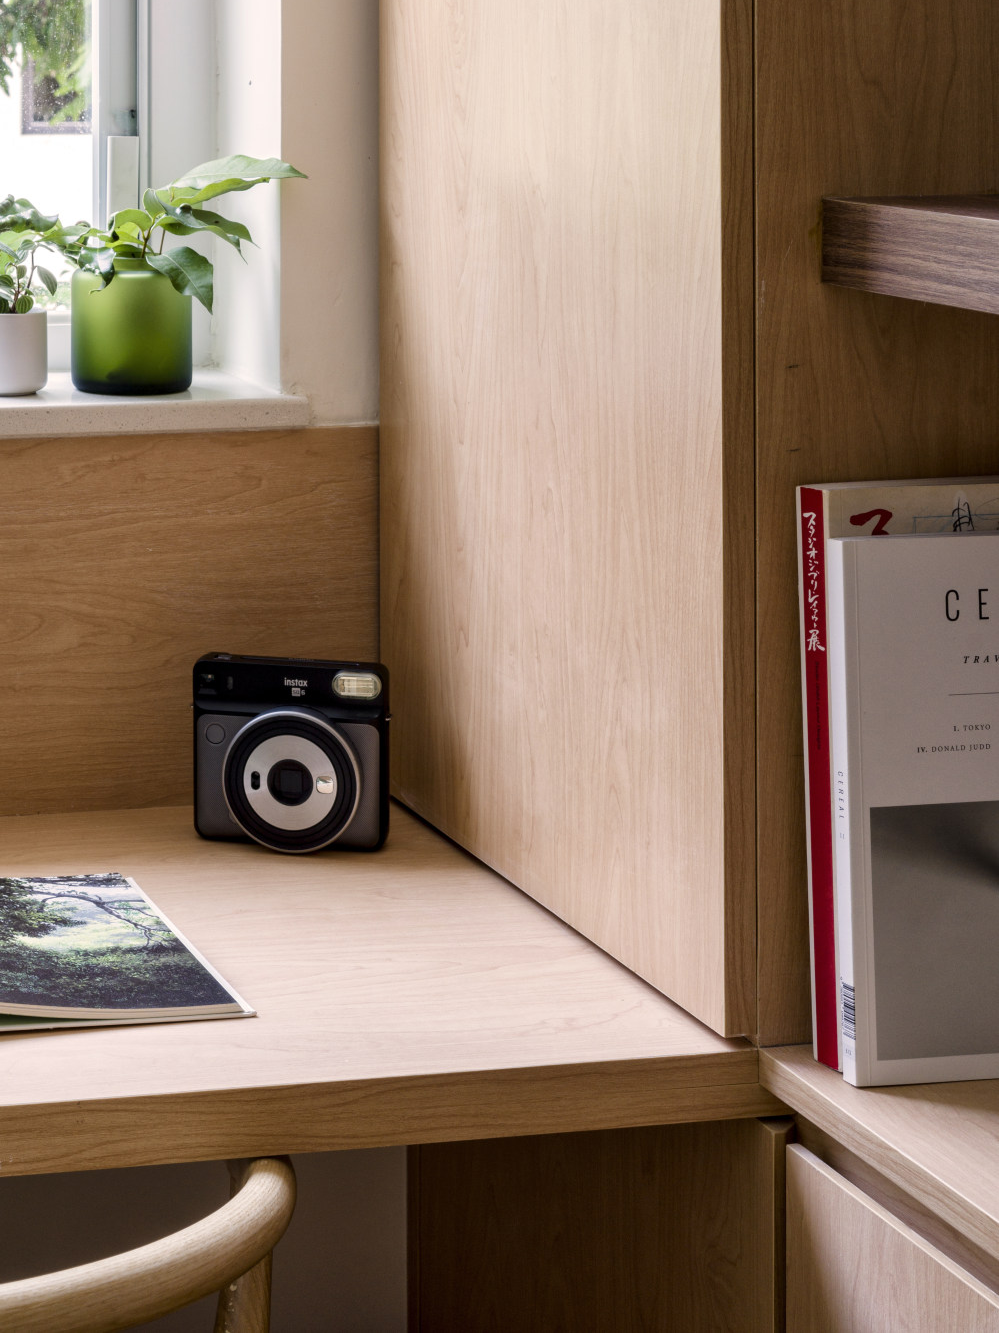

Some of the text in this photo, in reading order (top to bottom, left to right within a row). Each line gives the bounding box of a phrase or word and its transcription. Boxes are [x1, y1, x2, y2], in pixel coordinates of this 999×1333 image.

[284, 677, 308, 687] instax
[963, 724, 991, 732] TOKYO
[917, 744, 991, 754] IV. DONALD JUDD
[837, 770, 845, 819] CEREAL
